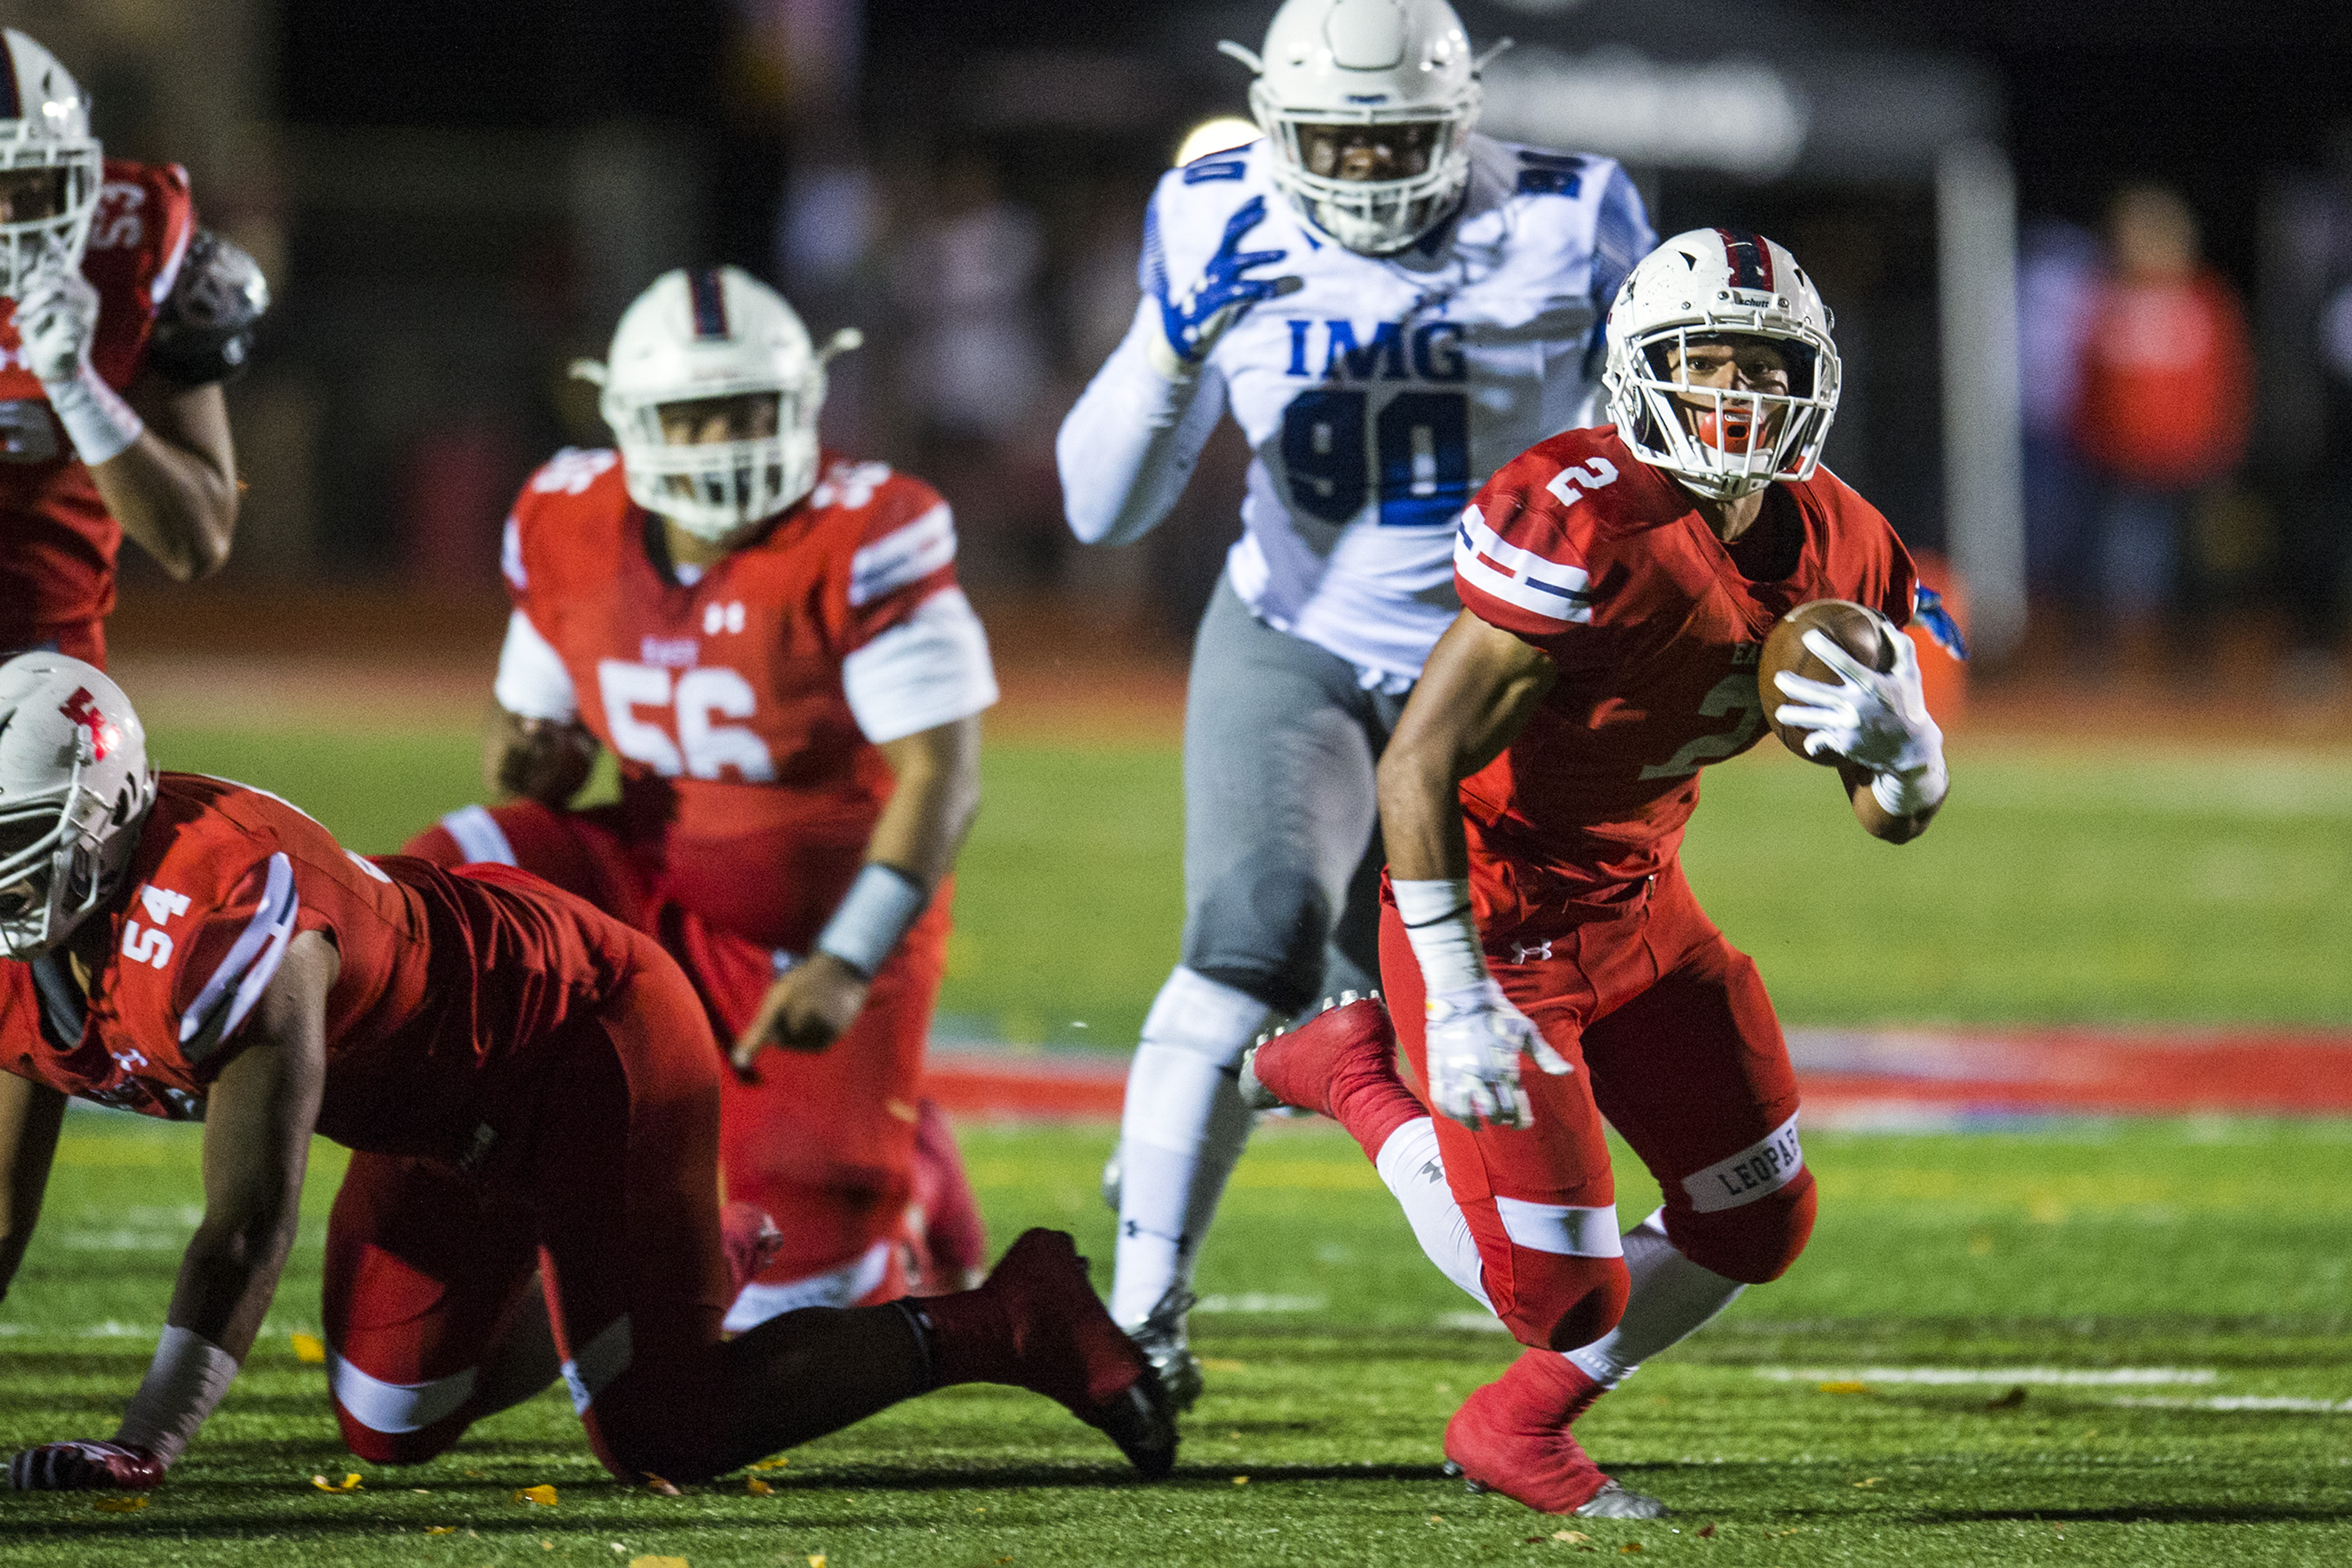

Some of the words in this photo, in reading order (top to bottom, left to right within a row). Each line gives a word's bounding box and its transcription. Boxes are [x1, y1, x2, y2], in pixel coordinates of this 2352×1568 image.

[1285, 320, 1468, 381] IMG
[1281, 390, 1468, 525] 90
[1545, 457, 1619, 507] 2
[596, 660, 774, 782] 56
[1637, 673, 1764, 782] 2
[122, 884, 193, 970] 54
